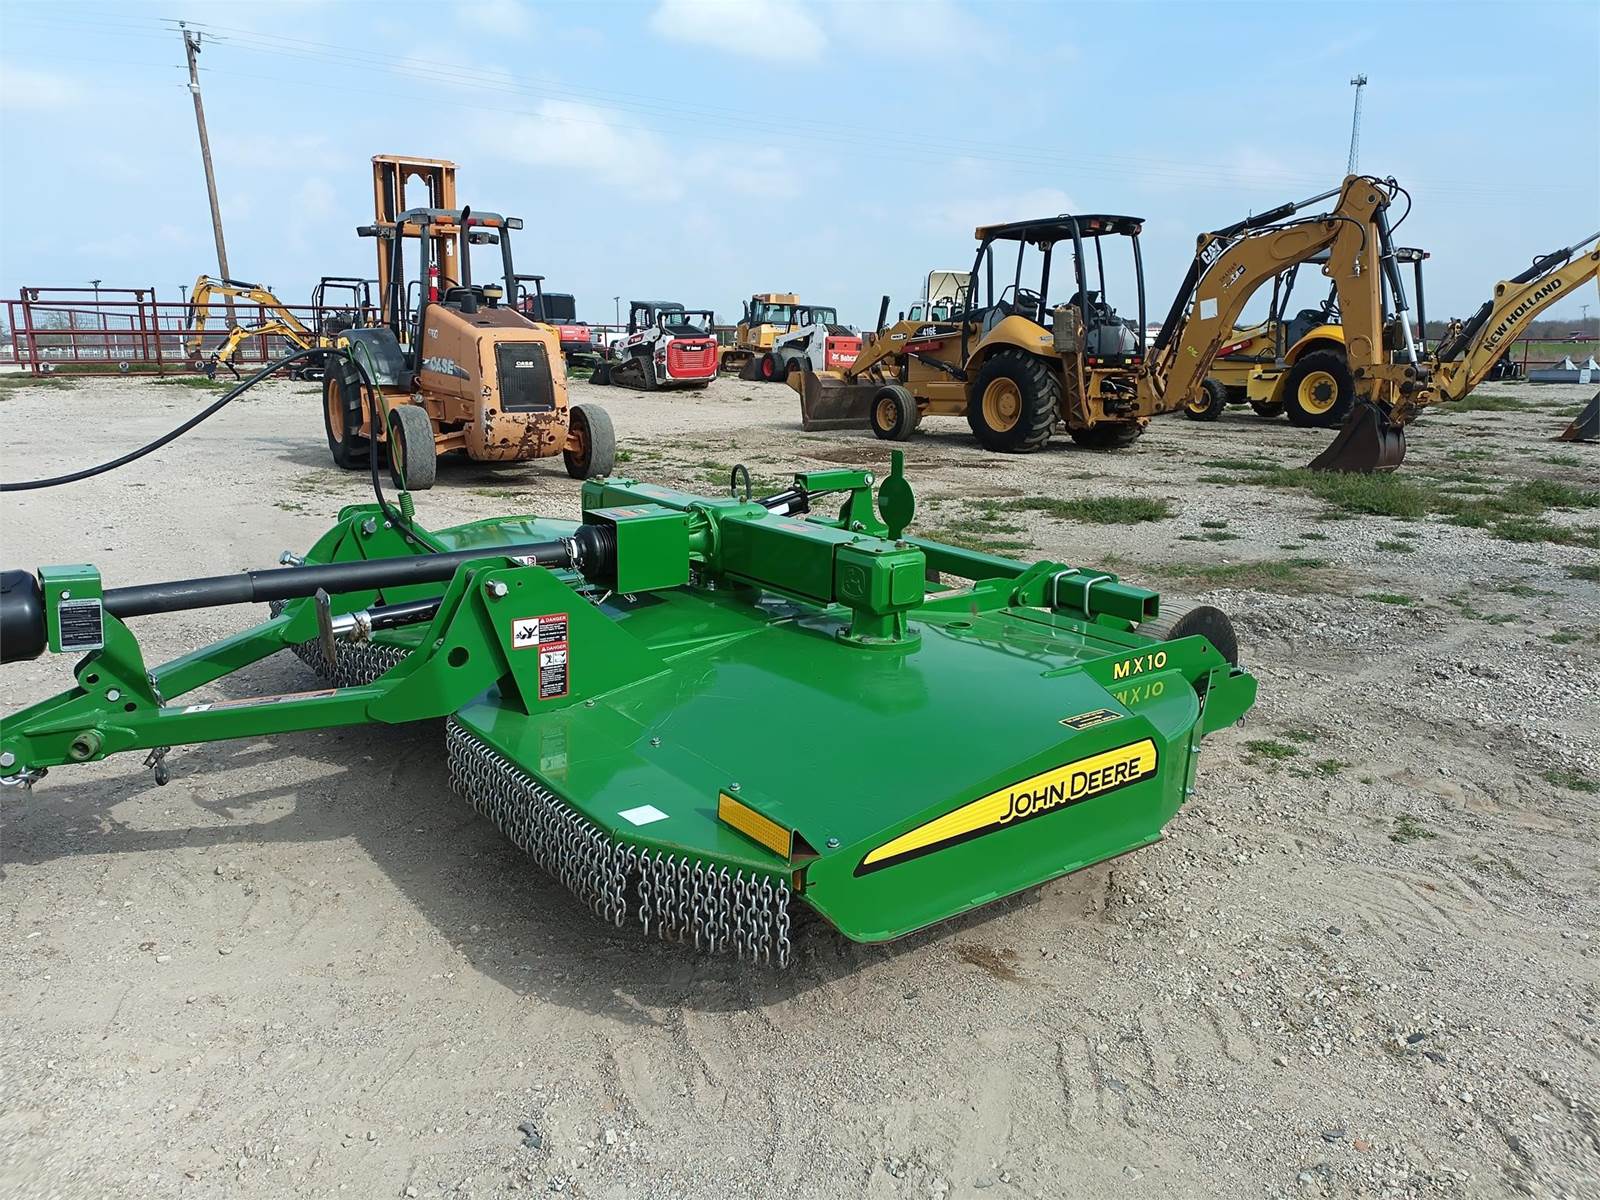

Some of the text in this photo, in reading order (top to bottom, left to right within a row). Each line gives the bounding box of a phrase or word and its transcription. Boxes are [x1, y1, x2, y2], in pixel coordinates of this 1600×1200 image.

[1200, 238, 1222, 265] CAT
[1483, 278, 1562, 352] NEW HOLLAND
[430, 356, 455, 375] CASE
[840, 353, 858, 362] Bobca
[1113, 651, 1168, 680] MX10
[1000, 756, 1141, 821] JOHN DEERE
